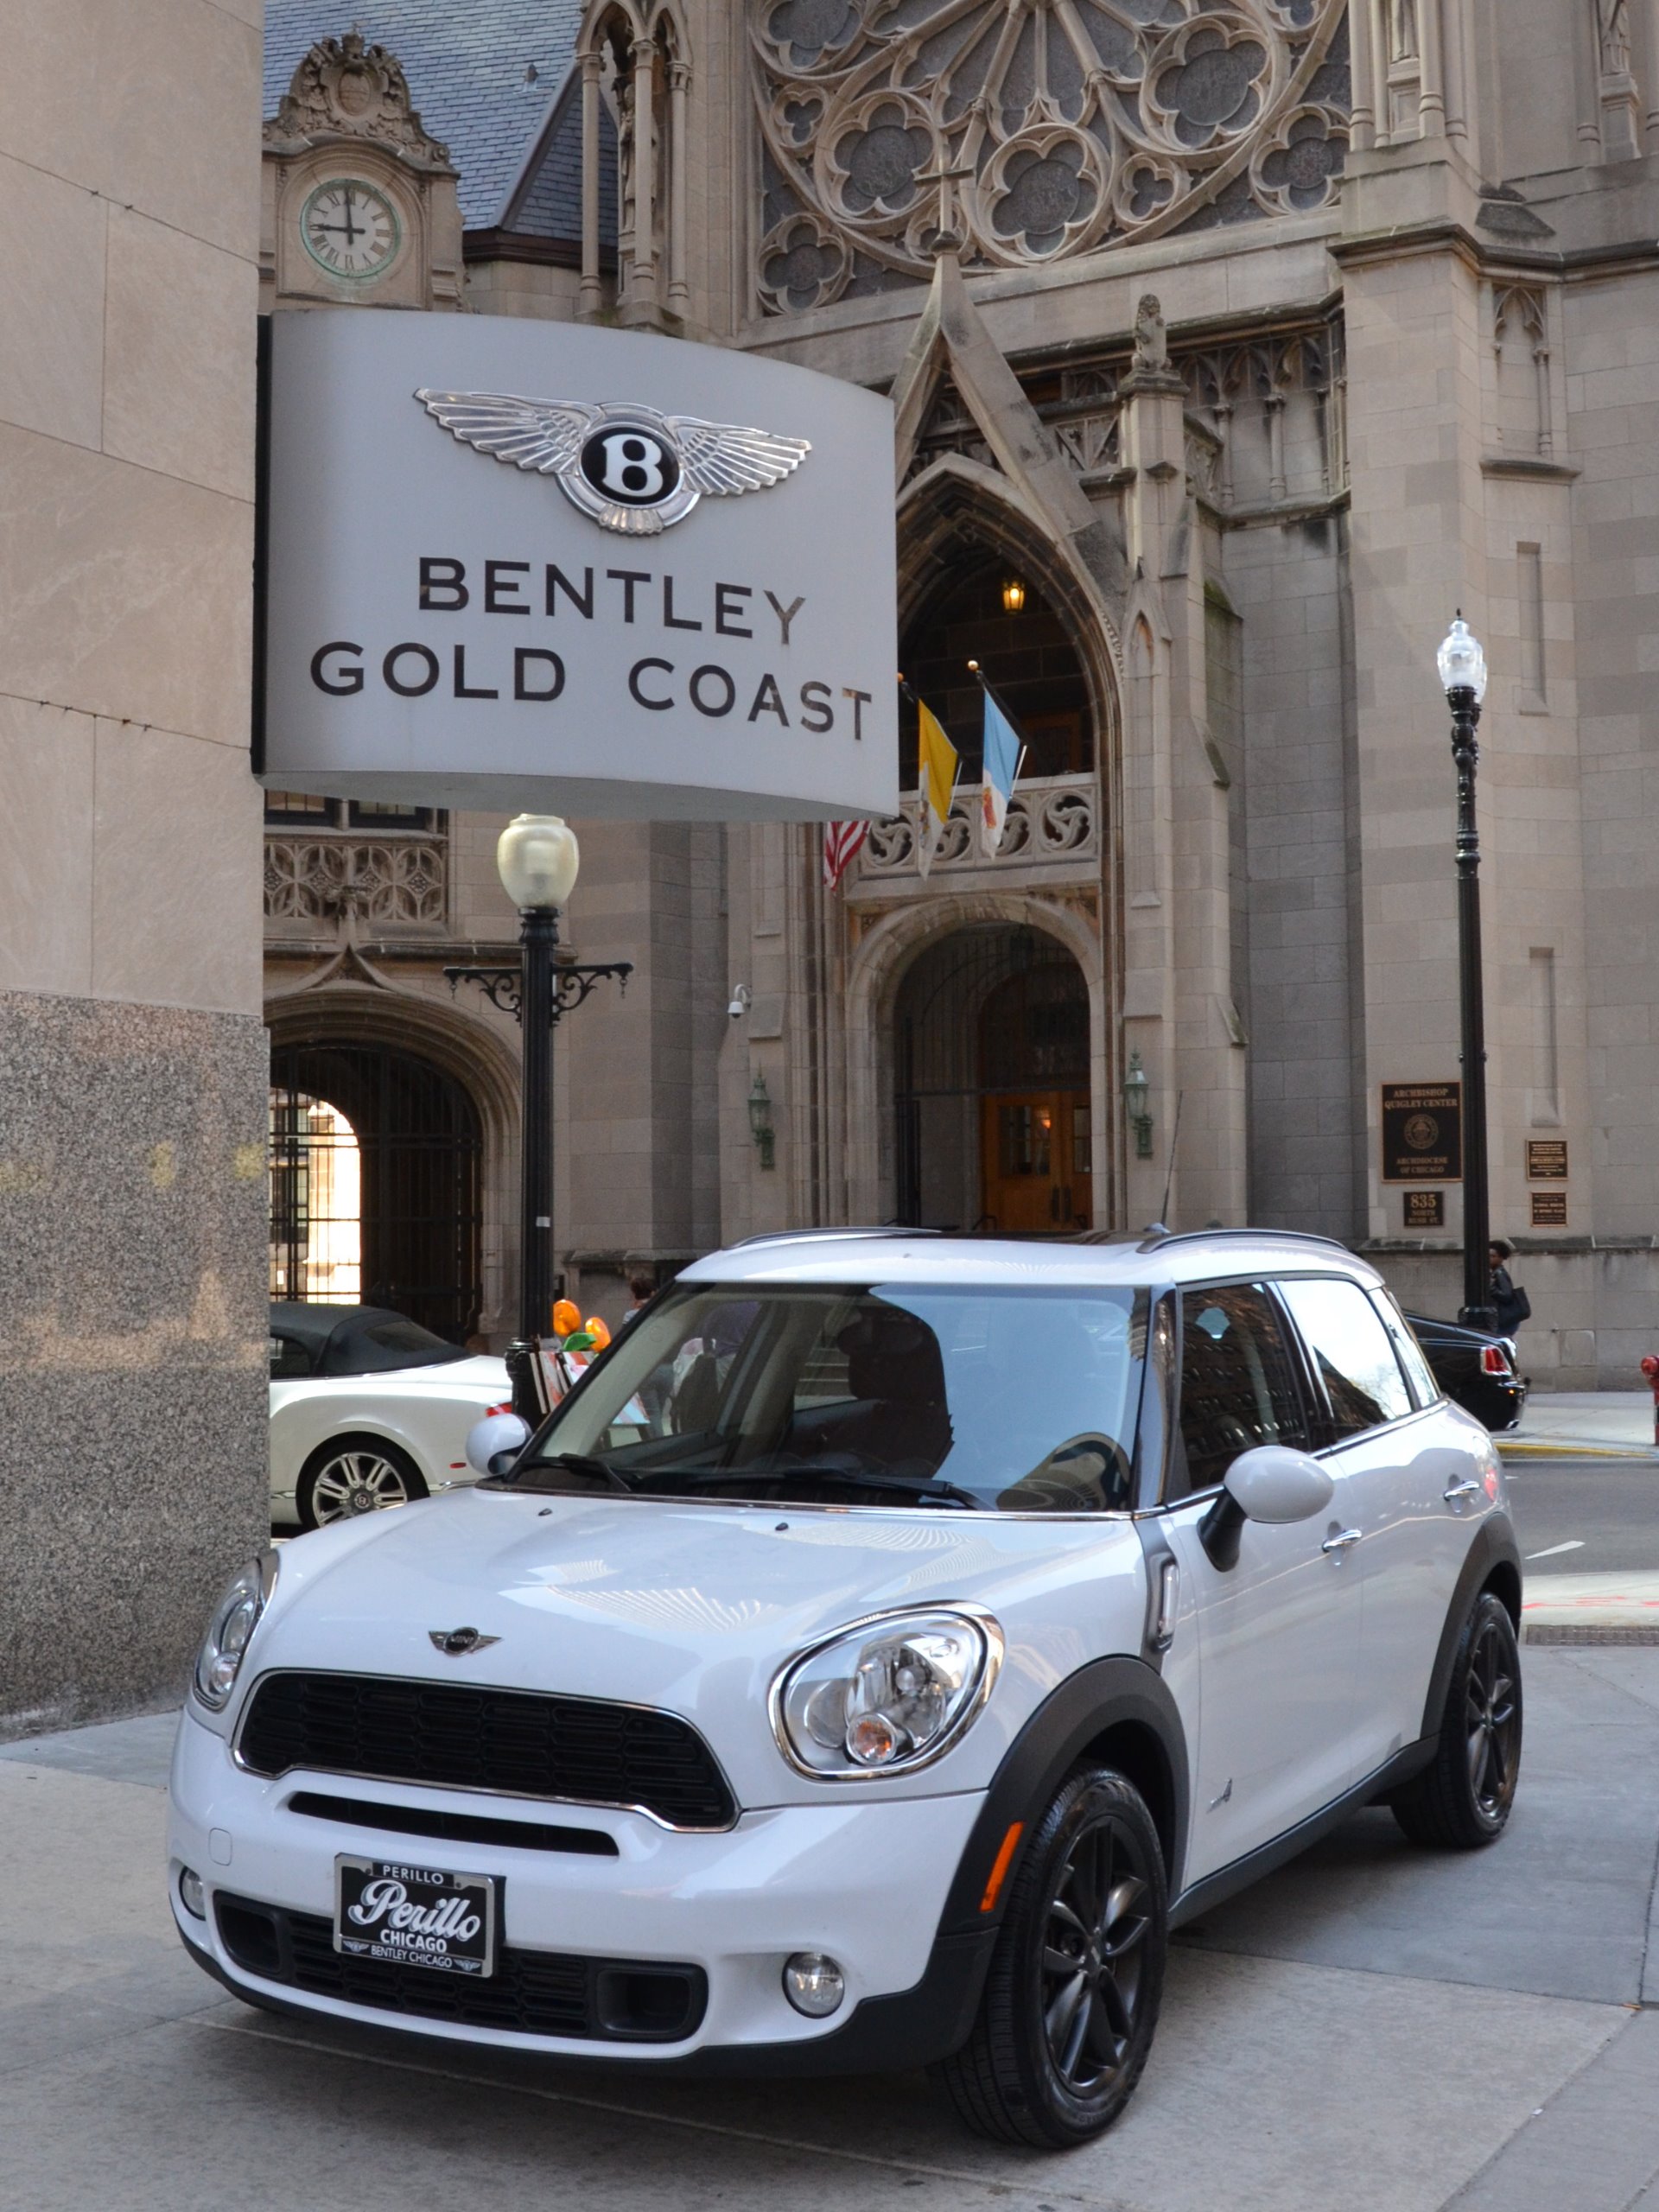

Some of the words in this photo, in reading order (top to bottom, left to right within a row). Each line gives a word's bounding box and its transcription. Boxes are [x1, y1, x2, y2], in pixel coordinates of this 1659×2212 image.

[602, 434, 663, 497] B
[419, 556, 805, 645] BENTLEY
[309, 641, 566, 702] GOLD
[628, 657, 872, 741] COAST
[1384, 1099, 1421, 1109] QUIGLEY
[1423, 1098, 1458, 1107] CENTER
[1394, 1088, 1449, 1097] ARCHBISHOP
[1410, 1194, 1436, 1208] 835
[383, 1865, 444, 1885] PERILLO
[347, 1879, 480, 1942] Perillo
[379, 1929, 448, 1953] CHICAGO
[371, 1945, 407, 1961] BENTLEY
[409, 1951, 452, 1968] CHICAGO
